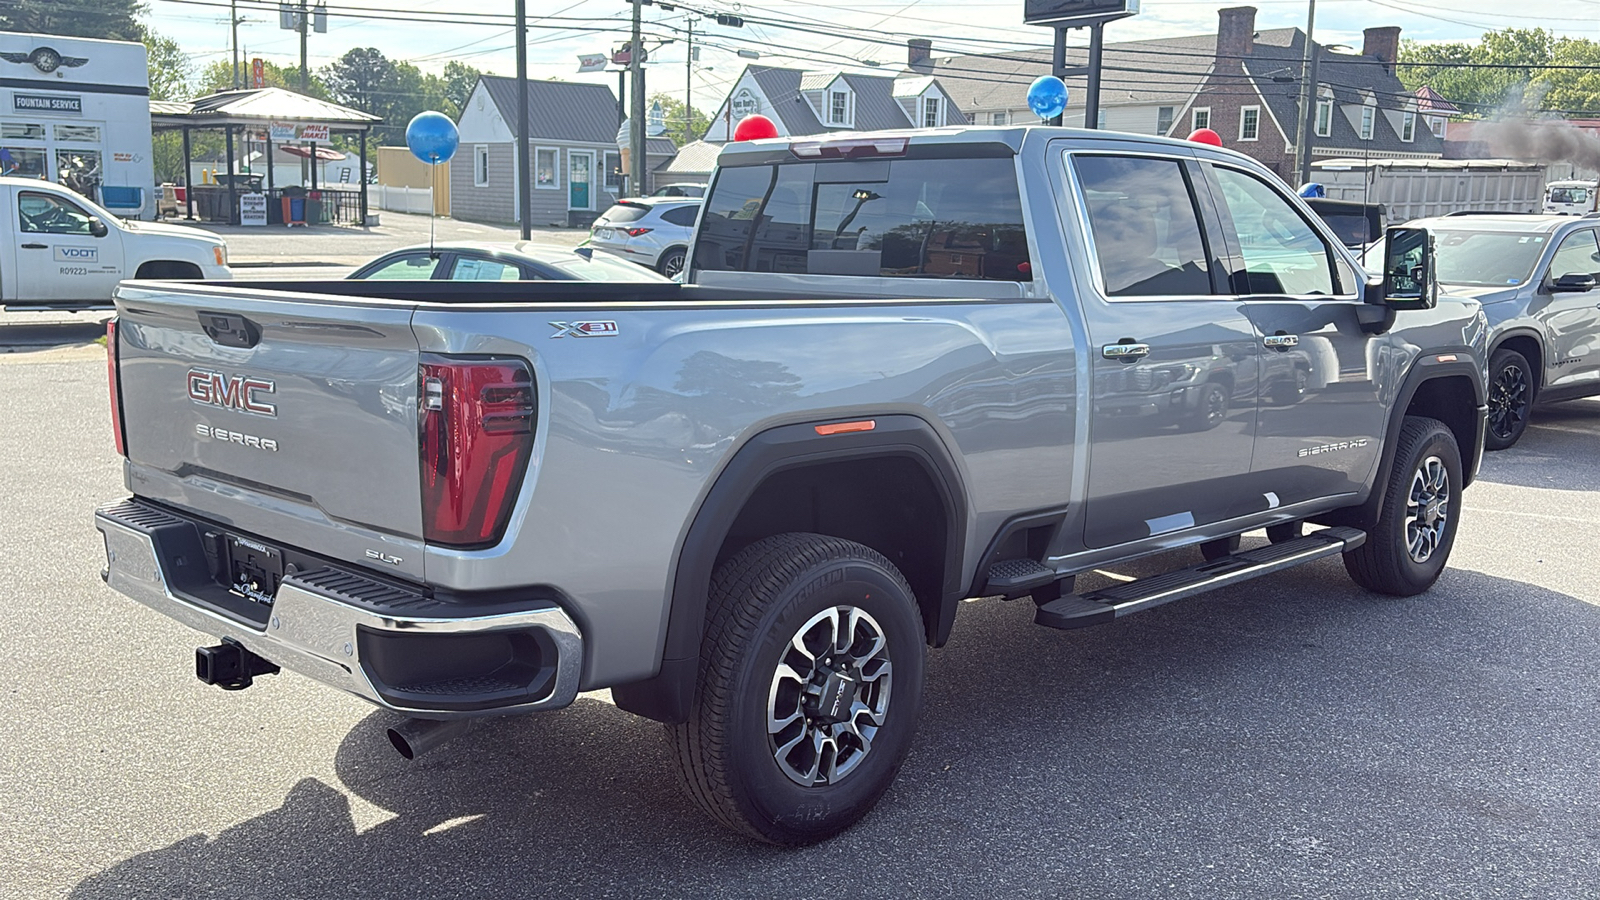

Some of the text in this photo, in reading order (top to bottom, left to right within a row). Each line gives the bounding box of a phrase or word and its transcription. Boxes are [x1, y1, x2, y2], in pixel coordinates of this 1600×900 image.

[17, 97, 79, 110] FOUNTAIN SERVICE
[301, 132, 328, 140] SHAKES
[62, 249, 97, 257] VDOT
[60, 267, 87, 275] R09223
[187, 368, 276, 418] GMC
[196, 424, 279, 452] SIERRA
[1298, 439, 1368, 457] SIERRA HD
[365, 549, 404, 565] SLT
[782, 567, 843, 620] MICHELIN
